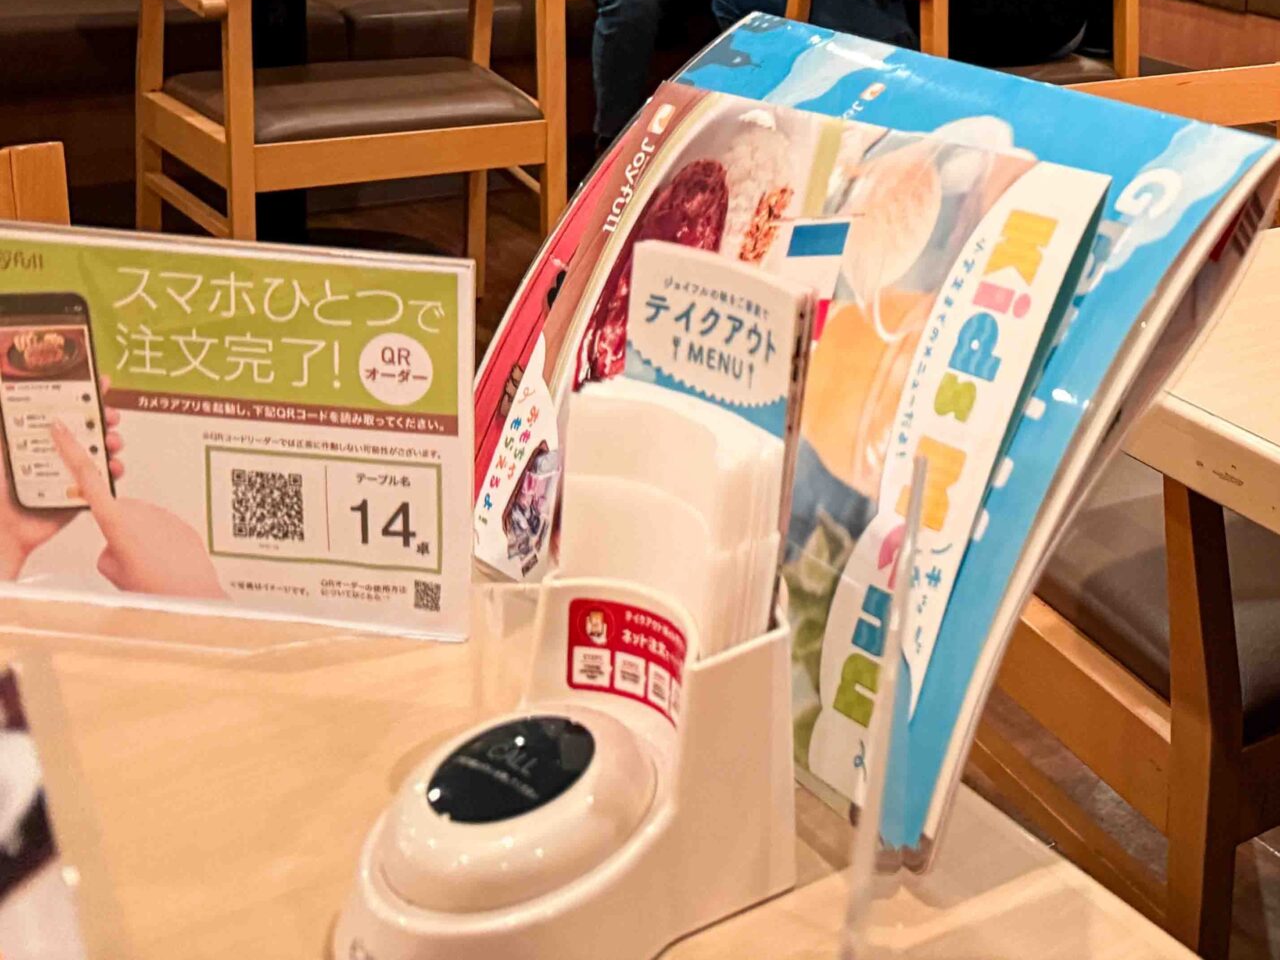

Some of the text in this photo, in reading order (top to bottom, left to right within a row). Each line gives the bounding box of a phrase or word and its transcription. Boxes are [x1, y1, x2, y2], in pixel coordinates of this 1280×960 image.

[602, 137, 655, 233] Joyfull
[0, 249, 43, 271] yfull
[113, 266, 446, 334] スマホひとつで
[934, 209, 1059, 424] Kids
[644, 293, 777, 363] テイクアウト
[116, 323, 342, 389] 注文完了!
[364, 367, 428, 386] オーダー
[380, 346, 411, 367] QR
[687, 344, 746, 381] MENU
[356, 472, 411, 488] テーブル名
